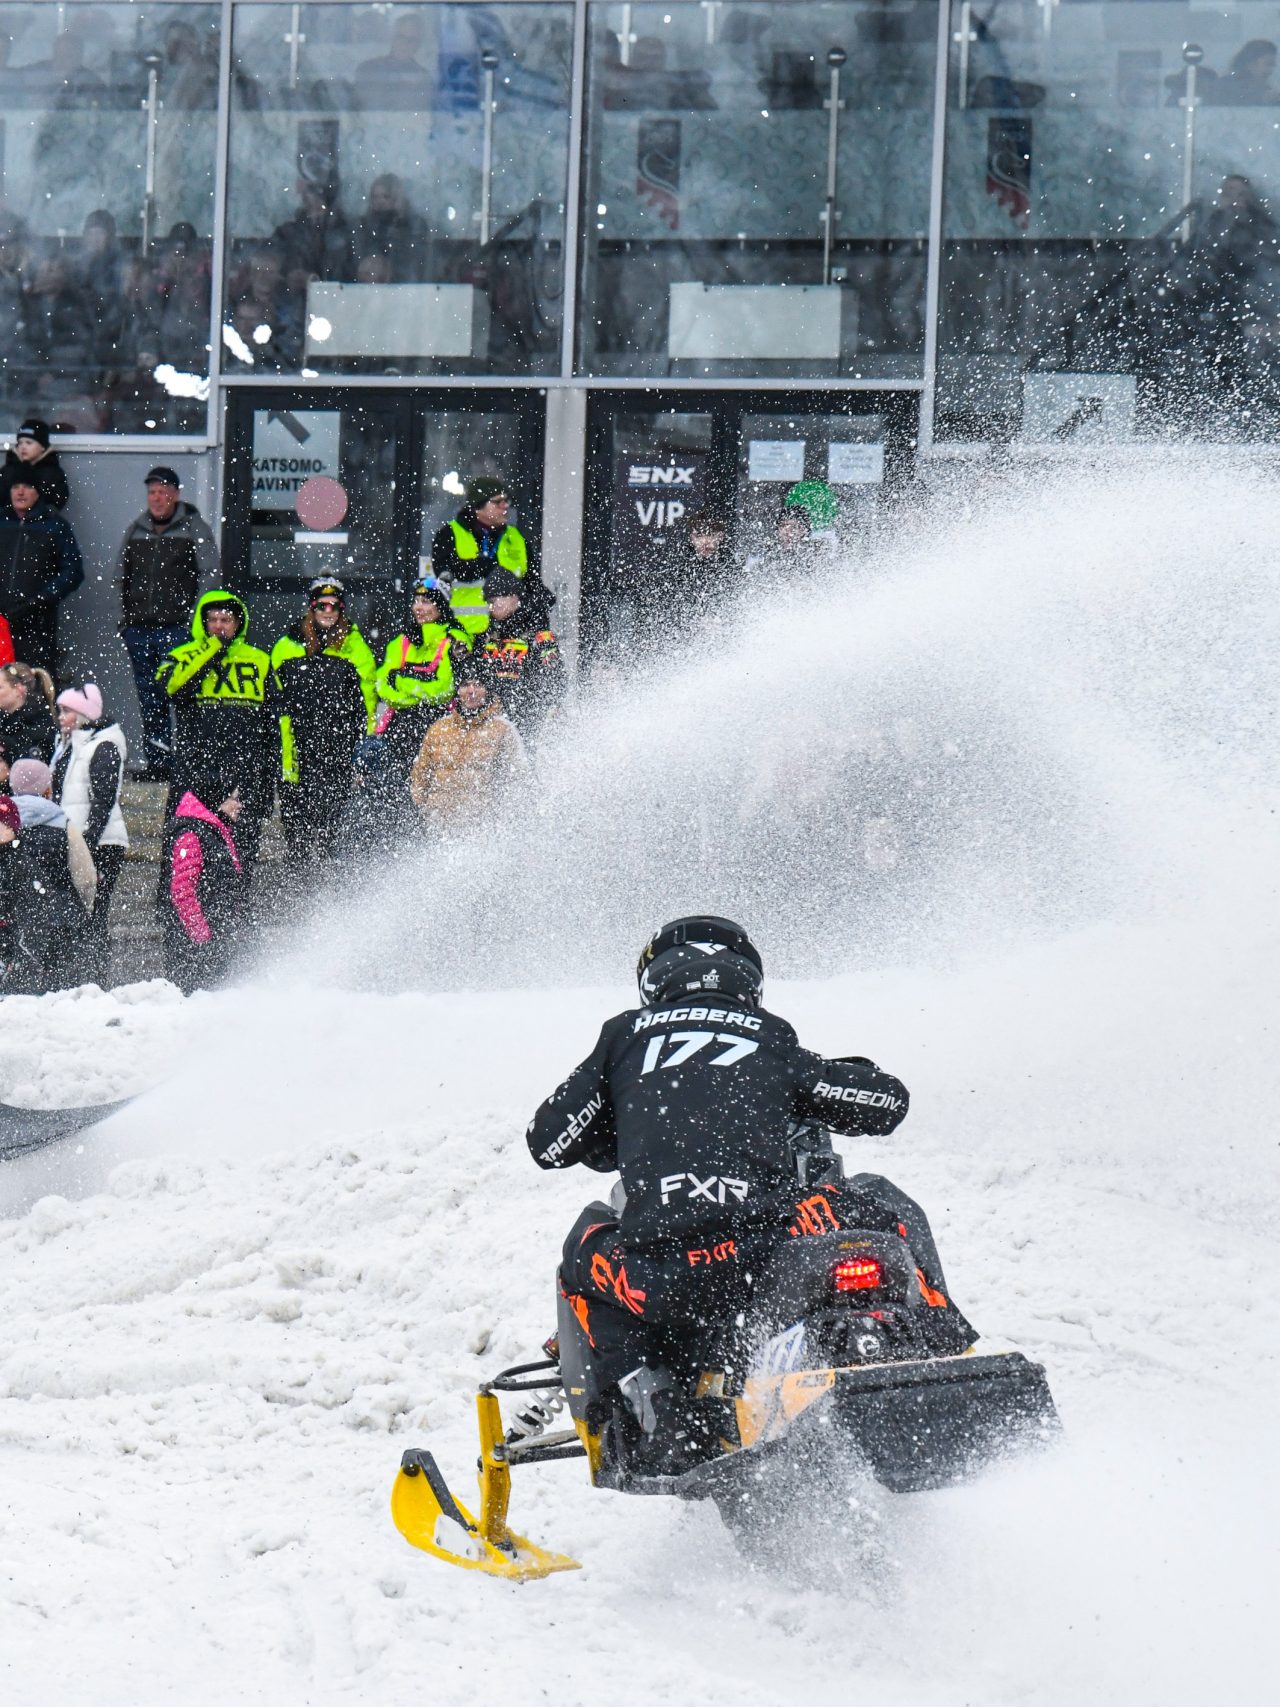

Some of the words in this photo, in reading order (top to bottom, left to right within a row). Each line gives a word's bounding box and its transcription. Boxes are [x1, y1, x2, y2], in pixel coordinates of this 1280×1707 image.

[628, 467, 696, 484] SNX
[636, 501, 685, 526] VIP
[633, 1007, 763, 1034] HAGBERG
[641, 1031, 760, 1076] 177
[661, 1173, 749, 1204] FXR
[688, 1240, 737, 1267] FXR
